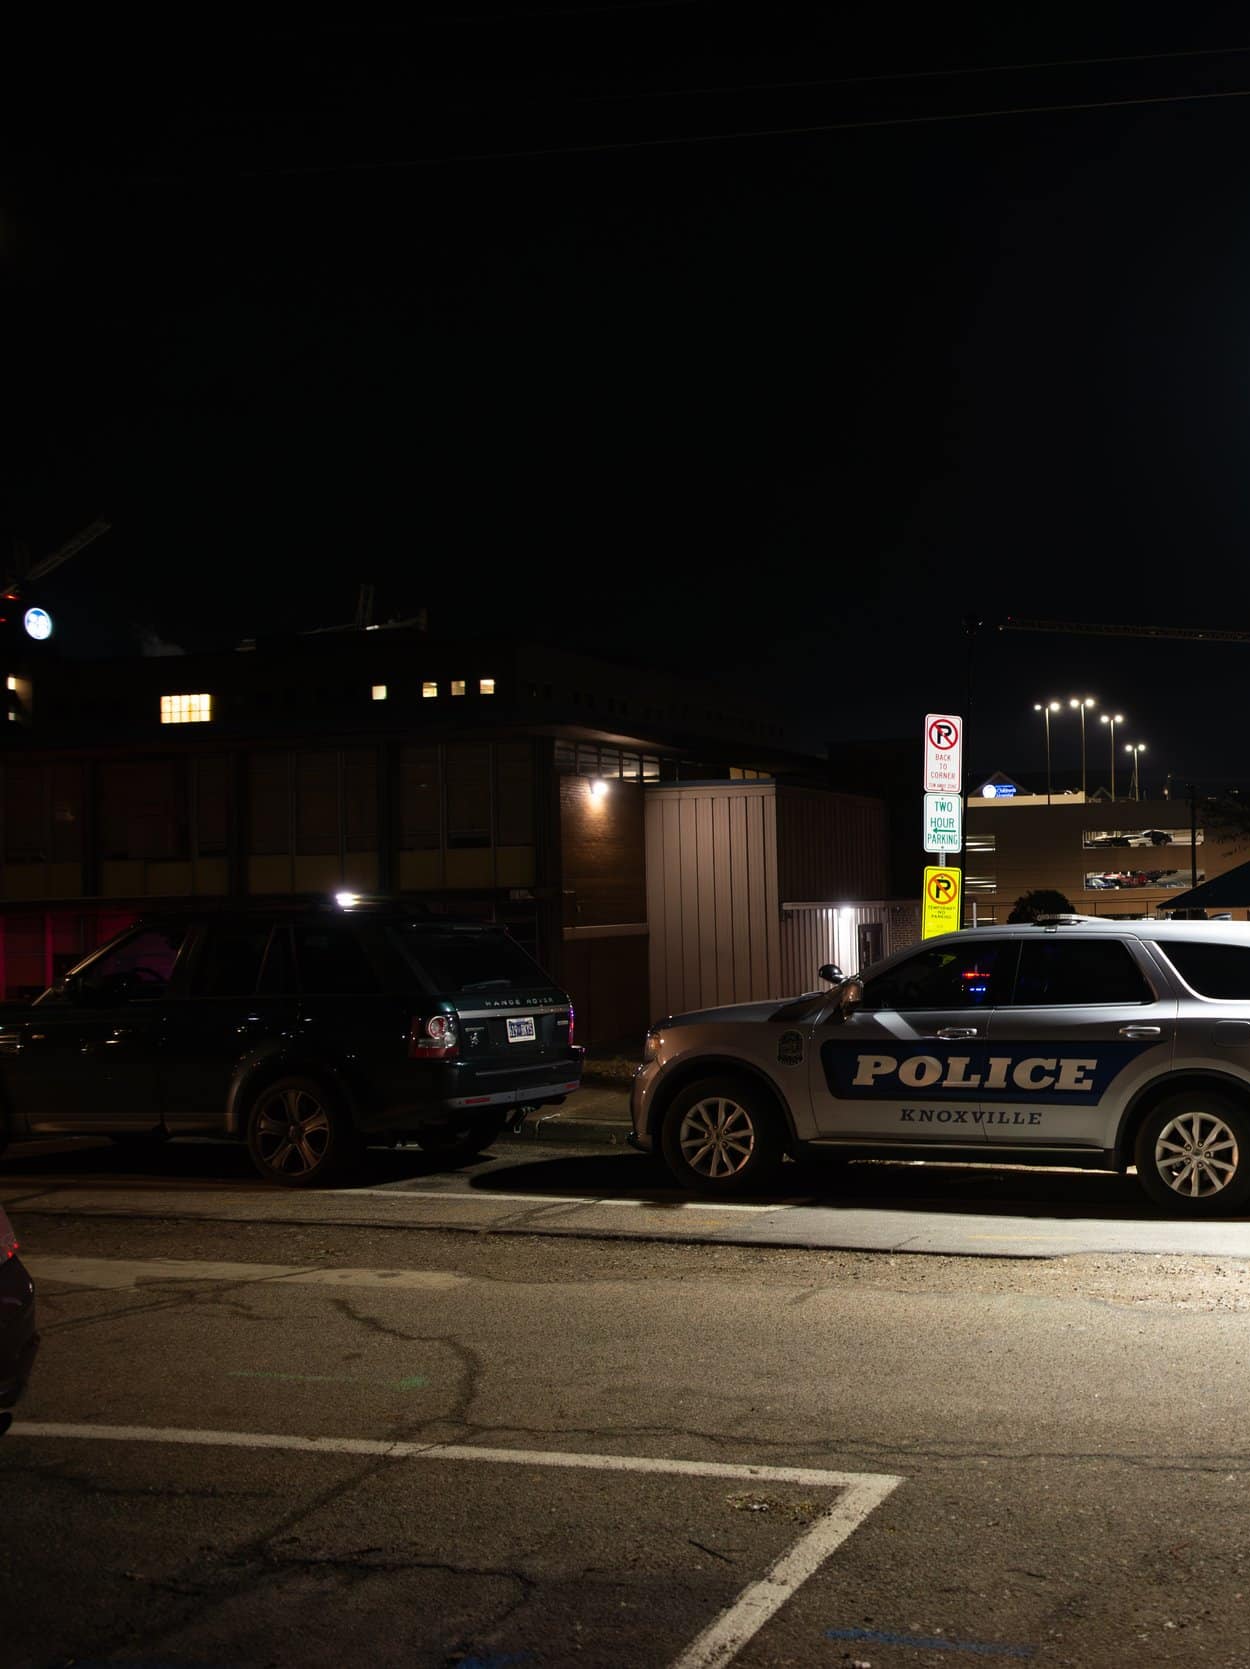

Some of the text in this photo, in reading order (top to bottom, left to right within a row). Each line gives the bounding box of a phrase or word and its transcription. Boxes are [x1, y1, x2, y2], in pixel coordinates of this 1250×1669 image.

[935, 753, 951, 761] BACK
[930, 771, 955, 779] CORNER
[935, 801, 953, 812] TWO
[930, 817, 955, 828] HOUR
[928, 833, 958, 845] PARKING
[852, 1054, 1098, 1091] POLICE
[901, 1108, 1043, 1125] KNOXVILLE
